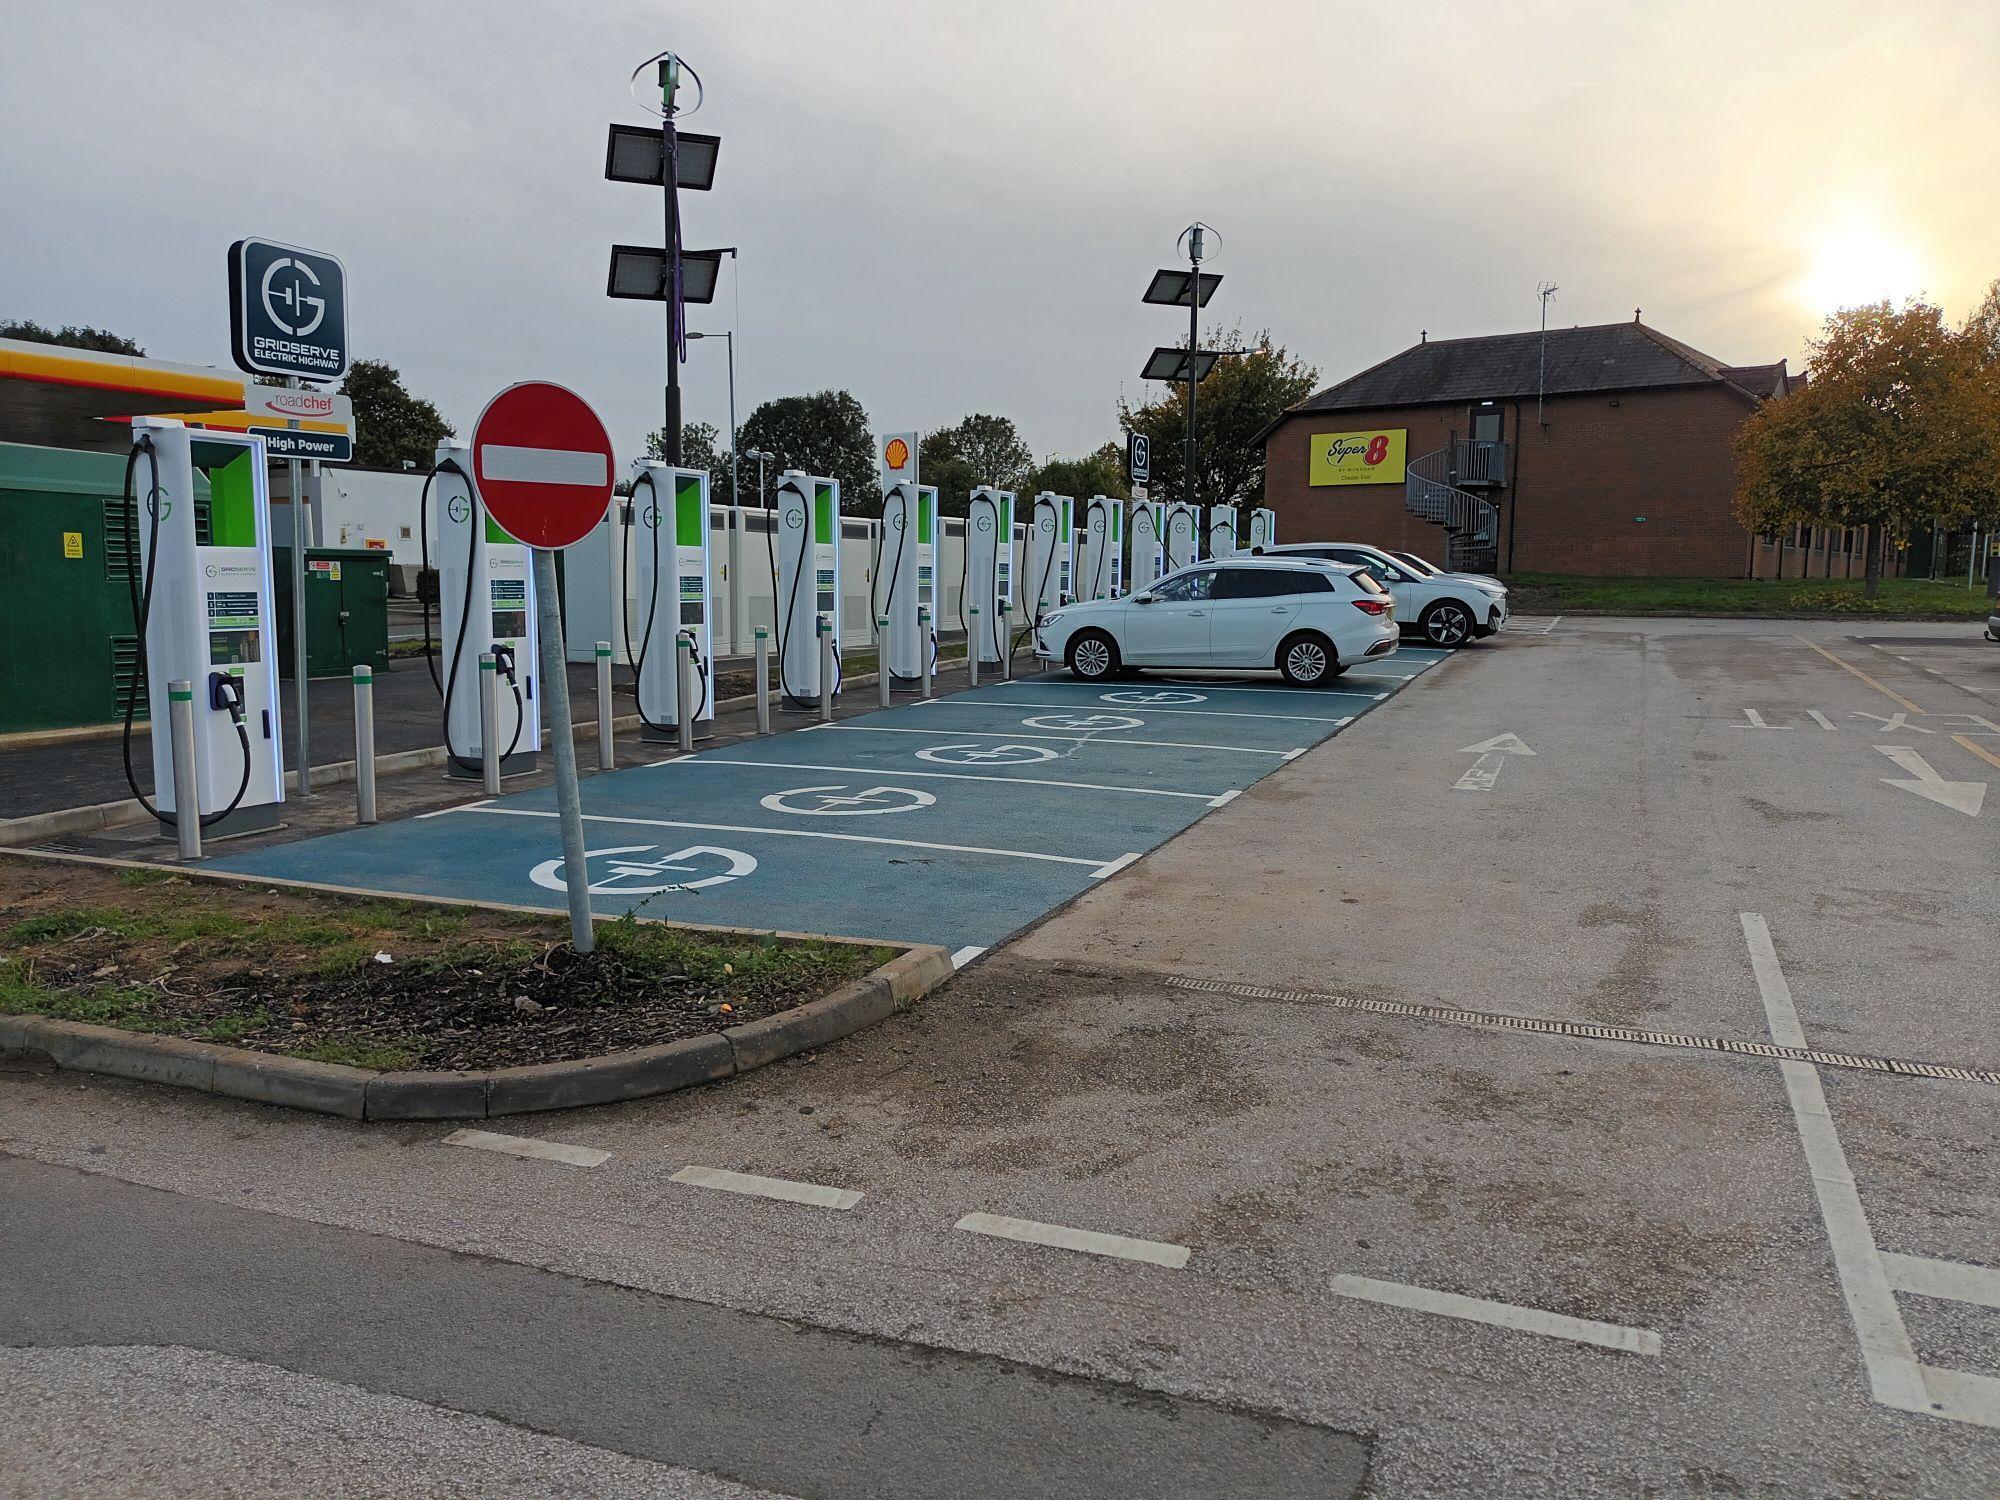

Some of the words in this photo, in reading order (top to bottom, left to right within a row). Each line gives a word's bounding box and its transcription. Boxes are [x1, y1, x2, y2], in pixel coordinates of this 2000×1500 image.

[254, 336, 340, 360] GRIDSERVE
[254, 348, 297, 363] ELECTRIC
[298, 355, 340, 370] HIGHWAY
[275, 393, 333, 410] roadchef
[267, 435, 295, 452] High
[298, 438, 335, 453] Power
[1327, 439, 1367, 464] Super
[1363, 435, 1390, 466] 8
